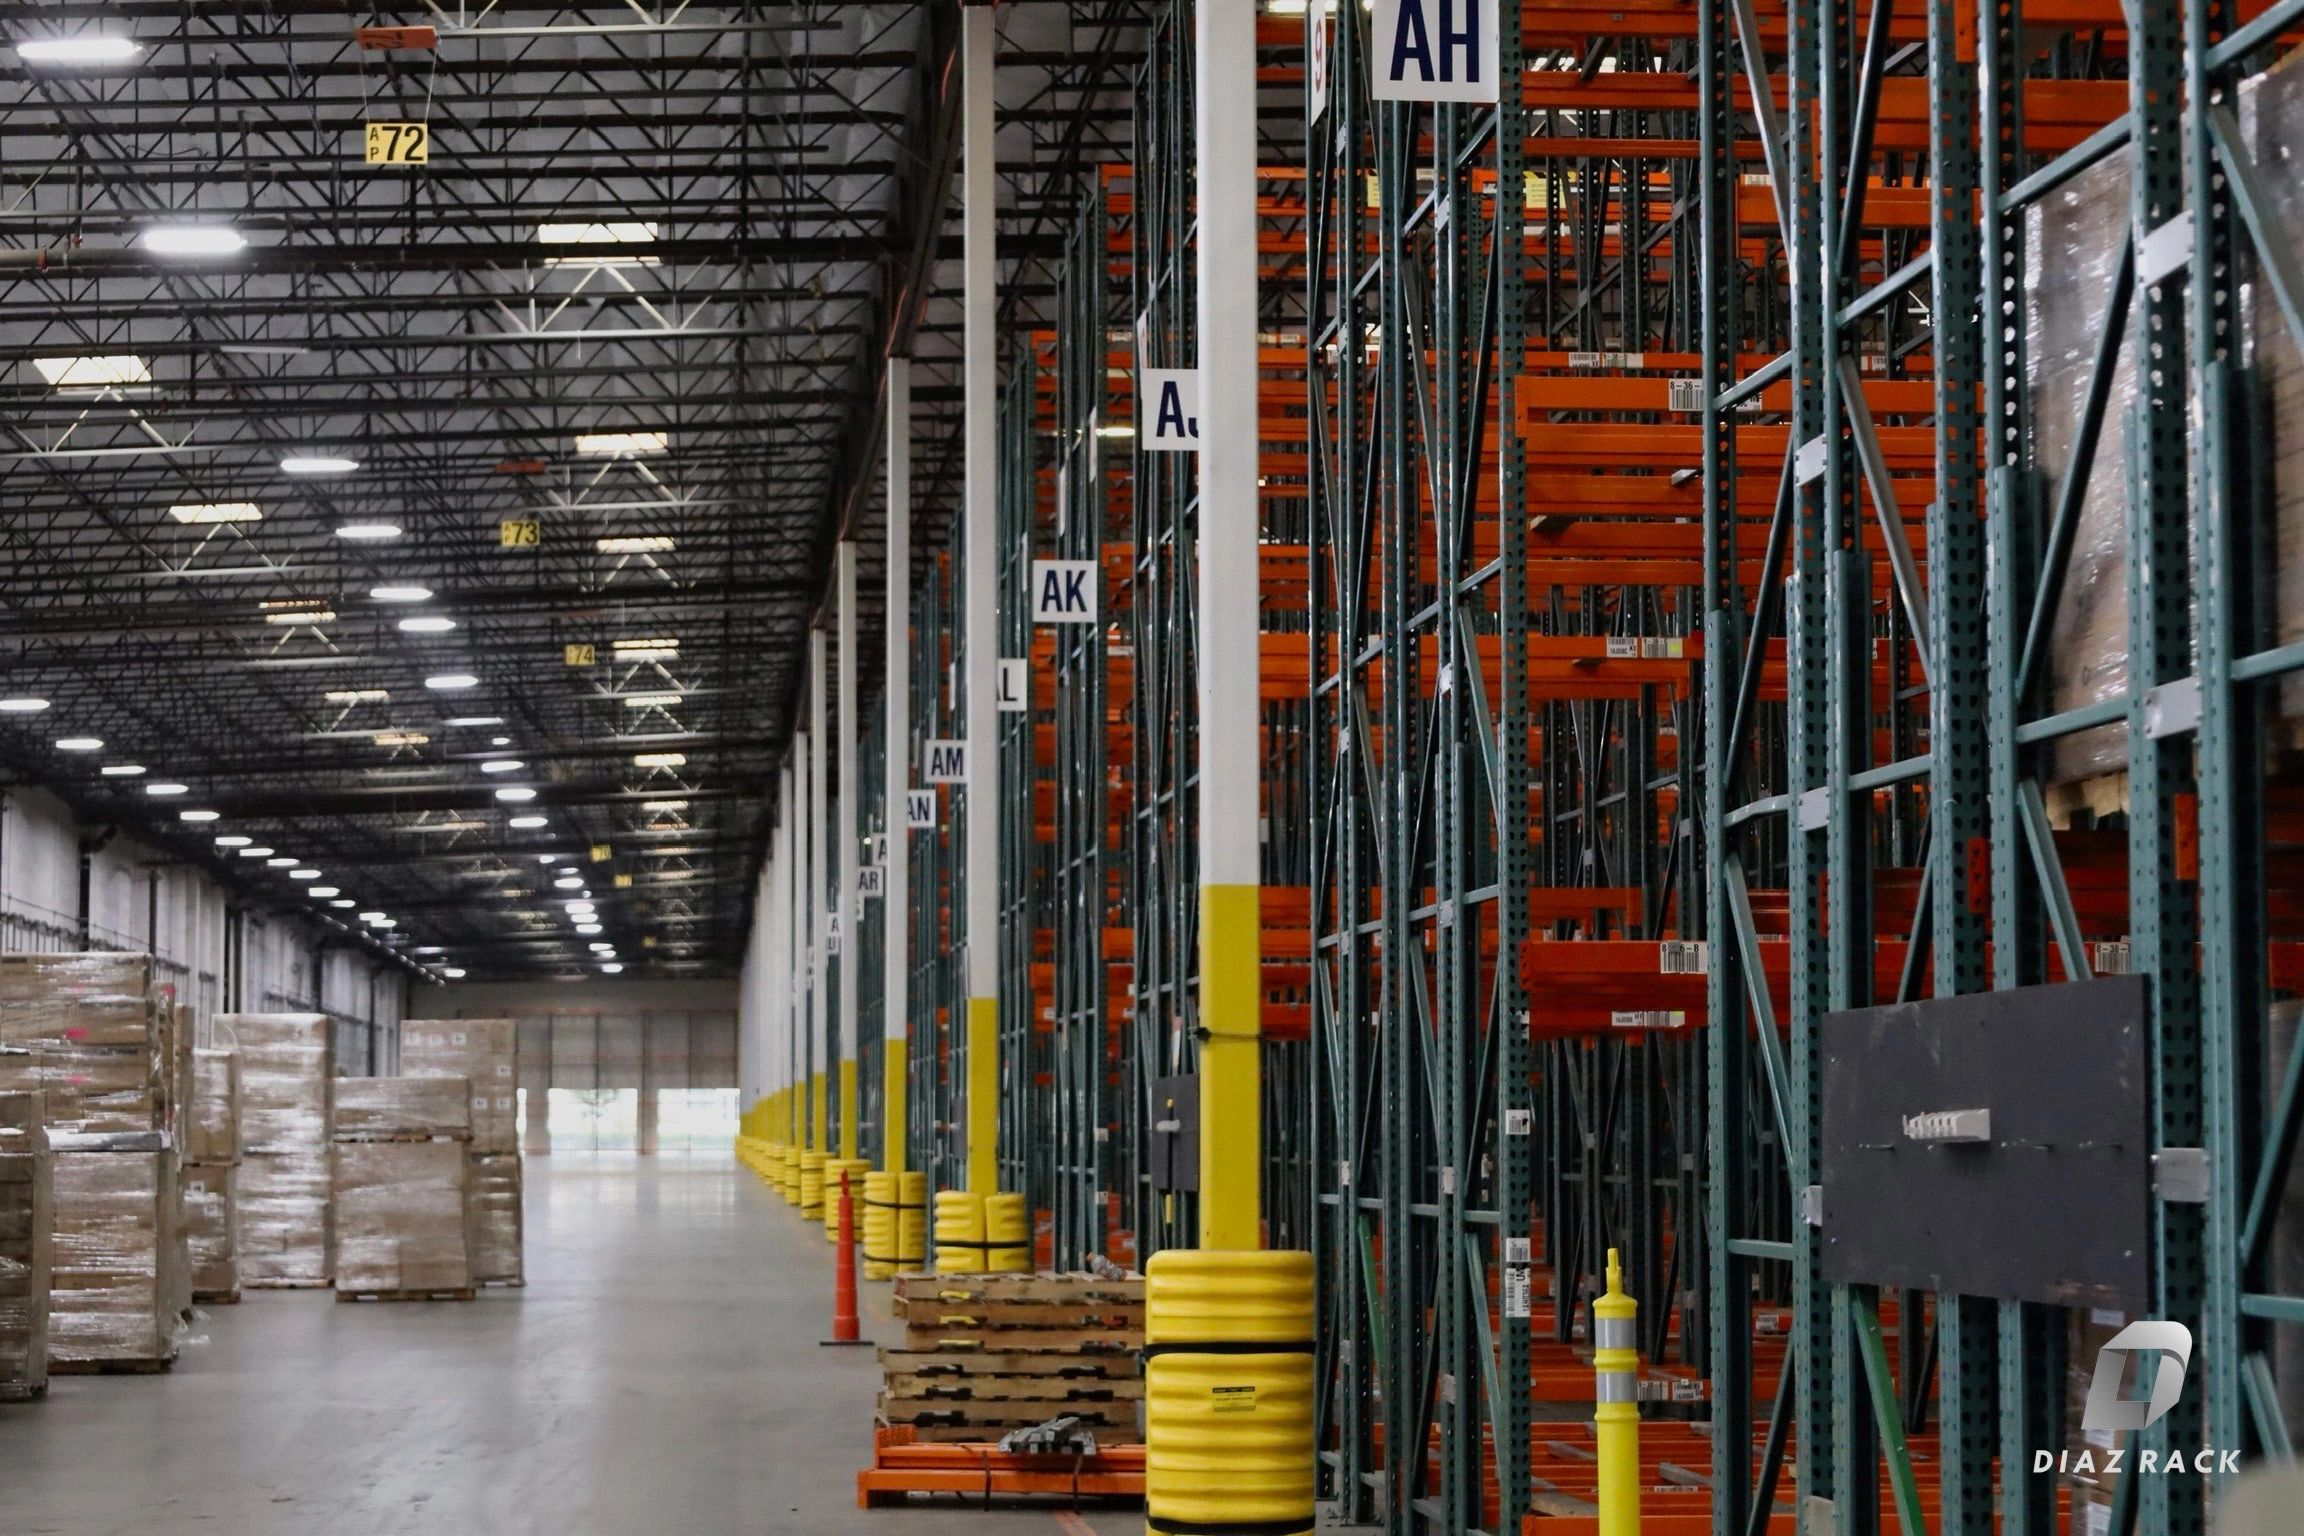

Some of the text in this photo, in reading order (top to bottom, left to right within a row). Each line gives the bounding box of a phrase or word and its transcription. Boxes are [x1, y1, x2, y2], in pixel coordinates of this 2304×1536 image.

[1390, 0, 1479, 82] AH
[382, 126, 424, 161] 72
[1670, 382, 1701, 390] 8-36-
[511, 522, 538, 544] 73
[1041, 570, 1087, 612] AK
[931, 746, 964, 776] AM
[858, 871, 879, 890] AR
